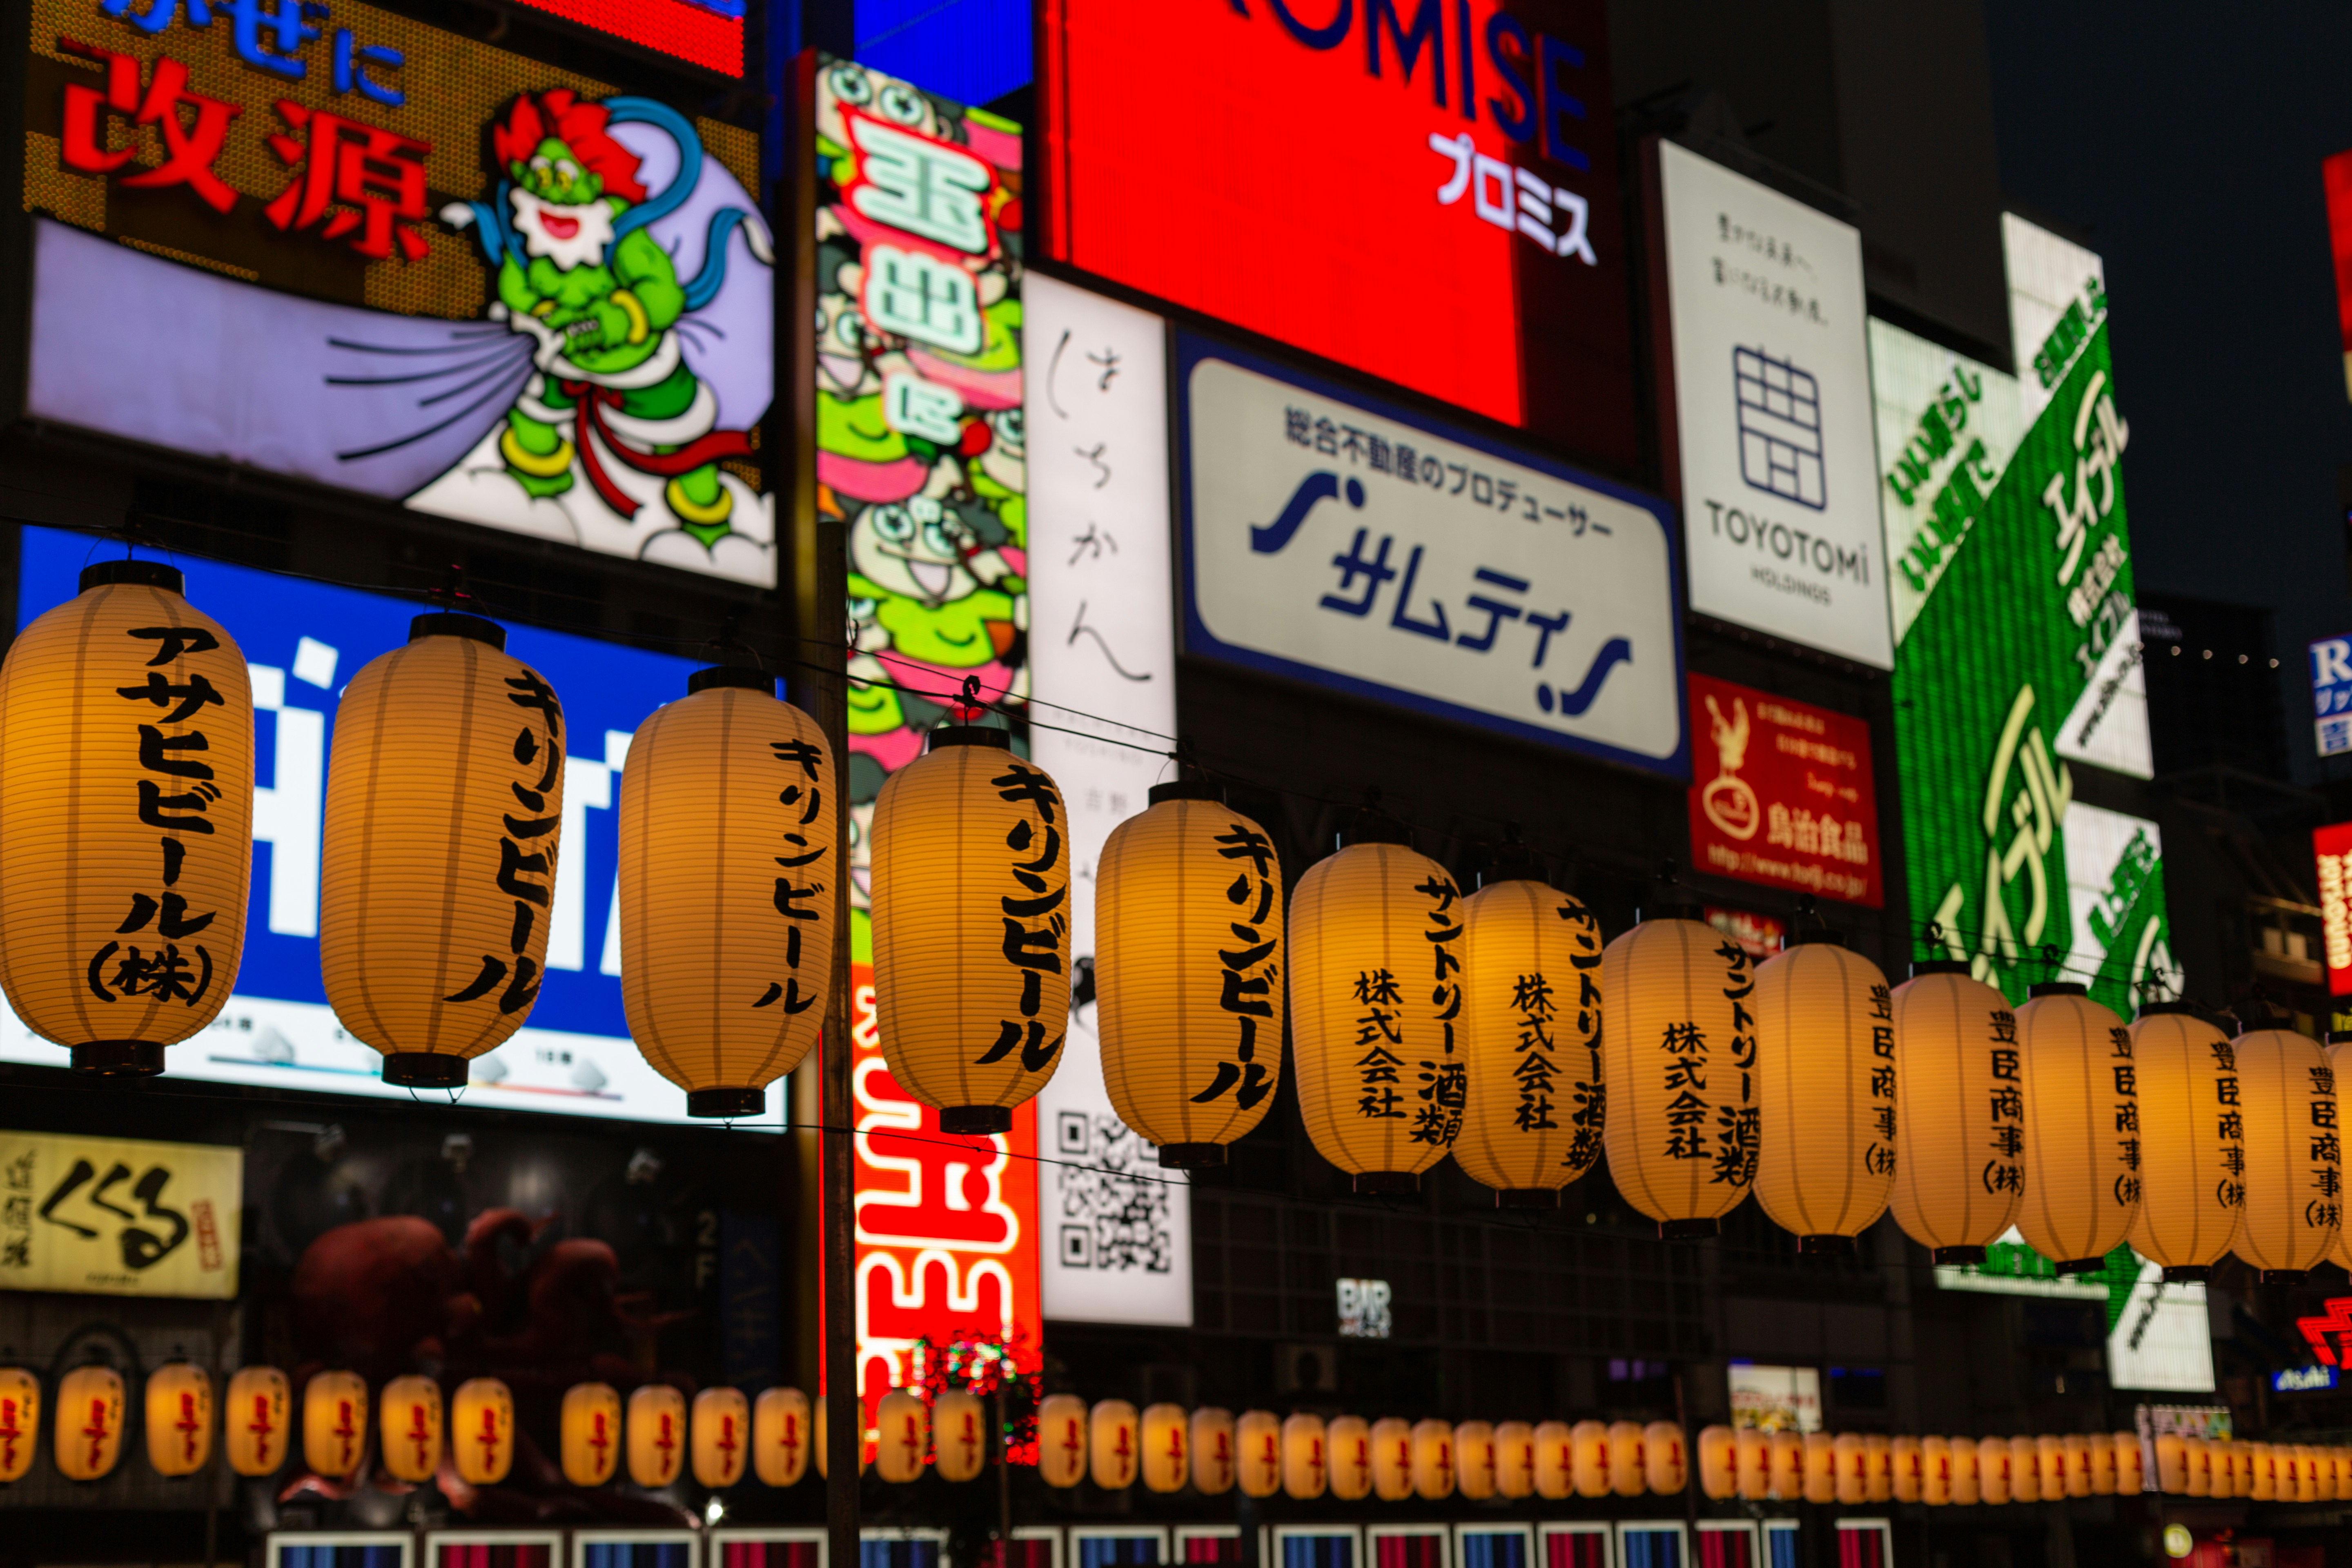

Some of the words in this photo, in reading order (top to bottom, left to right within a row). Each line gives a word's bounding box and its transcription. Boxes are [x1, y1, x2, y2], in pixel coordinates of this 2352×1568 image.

[60, 36, 433, 262] 改源
[1428, 131, 1598, 267] プロミス
[1046, 326, 1155, 683] はちかん
[1284, 404, 1614, 537] 総合不動産のプロデューサー
[1317, 526, 1573, 670] サムティ
[1748, 564, 1832, 606] HOLDINGS
[87, 626, 225, 1007] アサヒビール(株)
[442, 668, 564, 1015] キリンビール
[752, 738, 828, 1015] キリンビール
[973, 764, 1067, 1073] キリンビール
[1188, 824, 1278, 1111] キリンビール
[1351, 967, 1408, 1120] 株式会社
[1408, 874, 1468, 1149] サントリー酒類
[1510, 972, 1564, 1133] 株式会社
[1659, 1021, 1713, 1160] 株式会社
[1709, 940, 1761, 1189] サントリー酒類
[37, 1158, 190, 1272] くくる
[1336, 1278, 1392, 1321] BAR
[2276, 1364, 2331, 1390] Asahi
